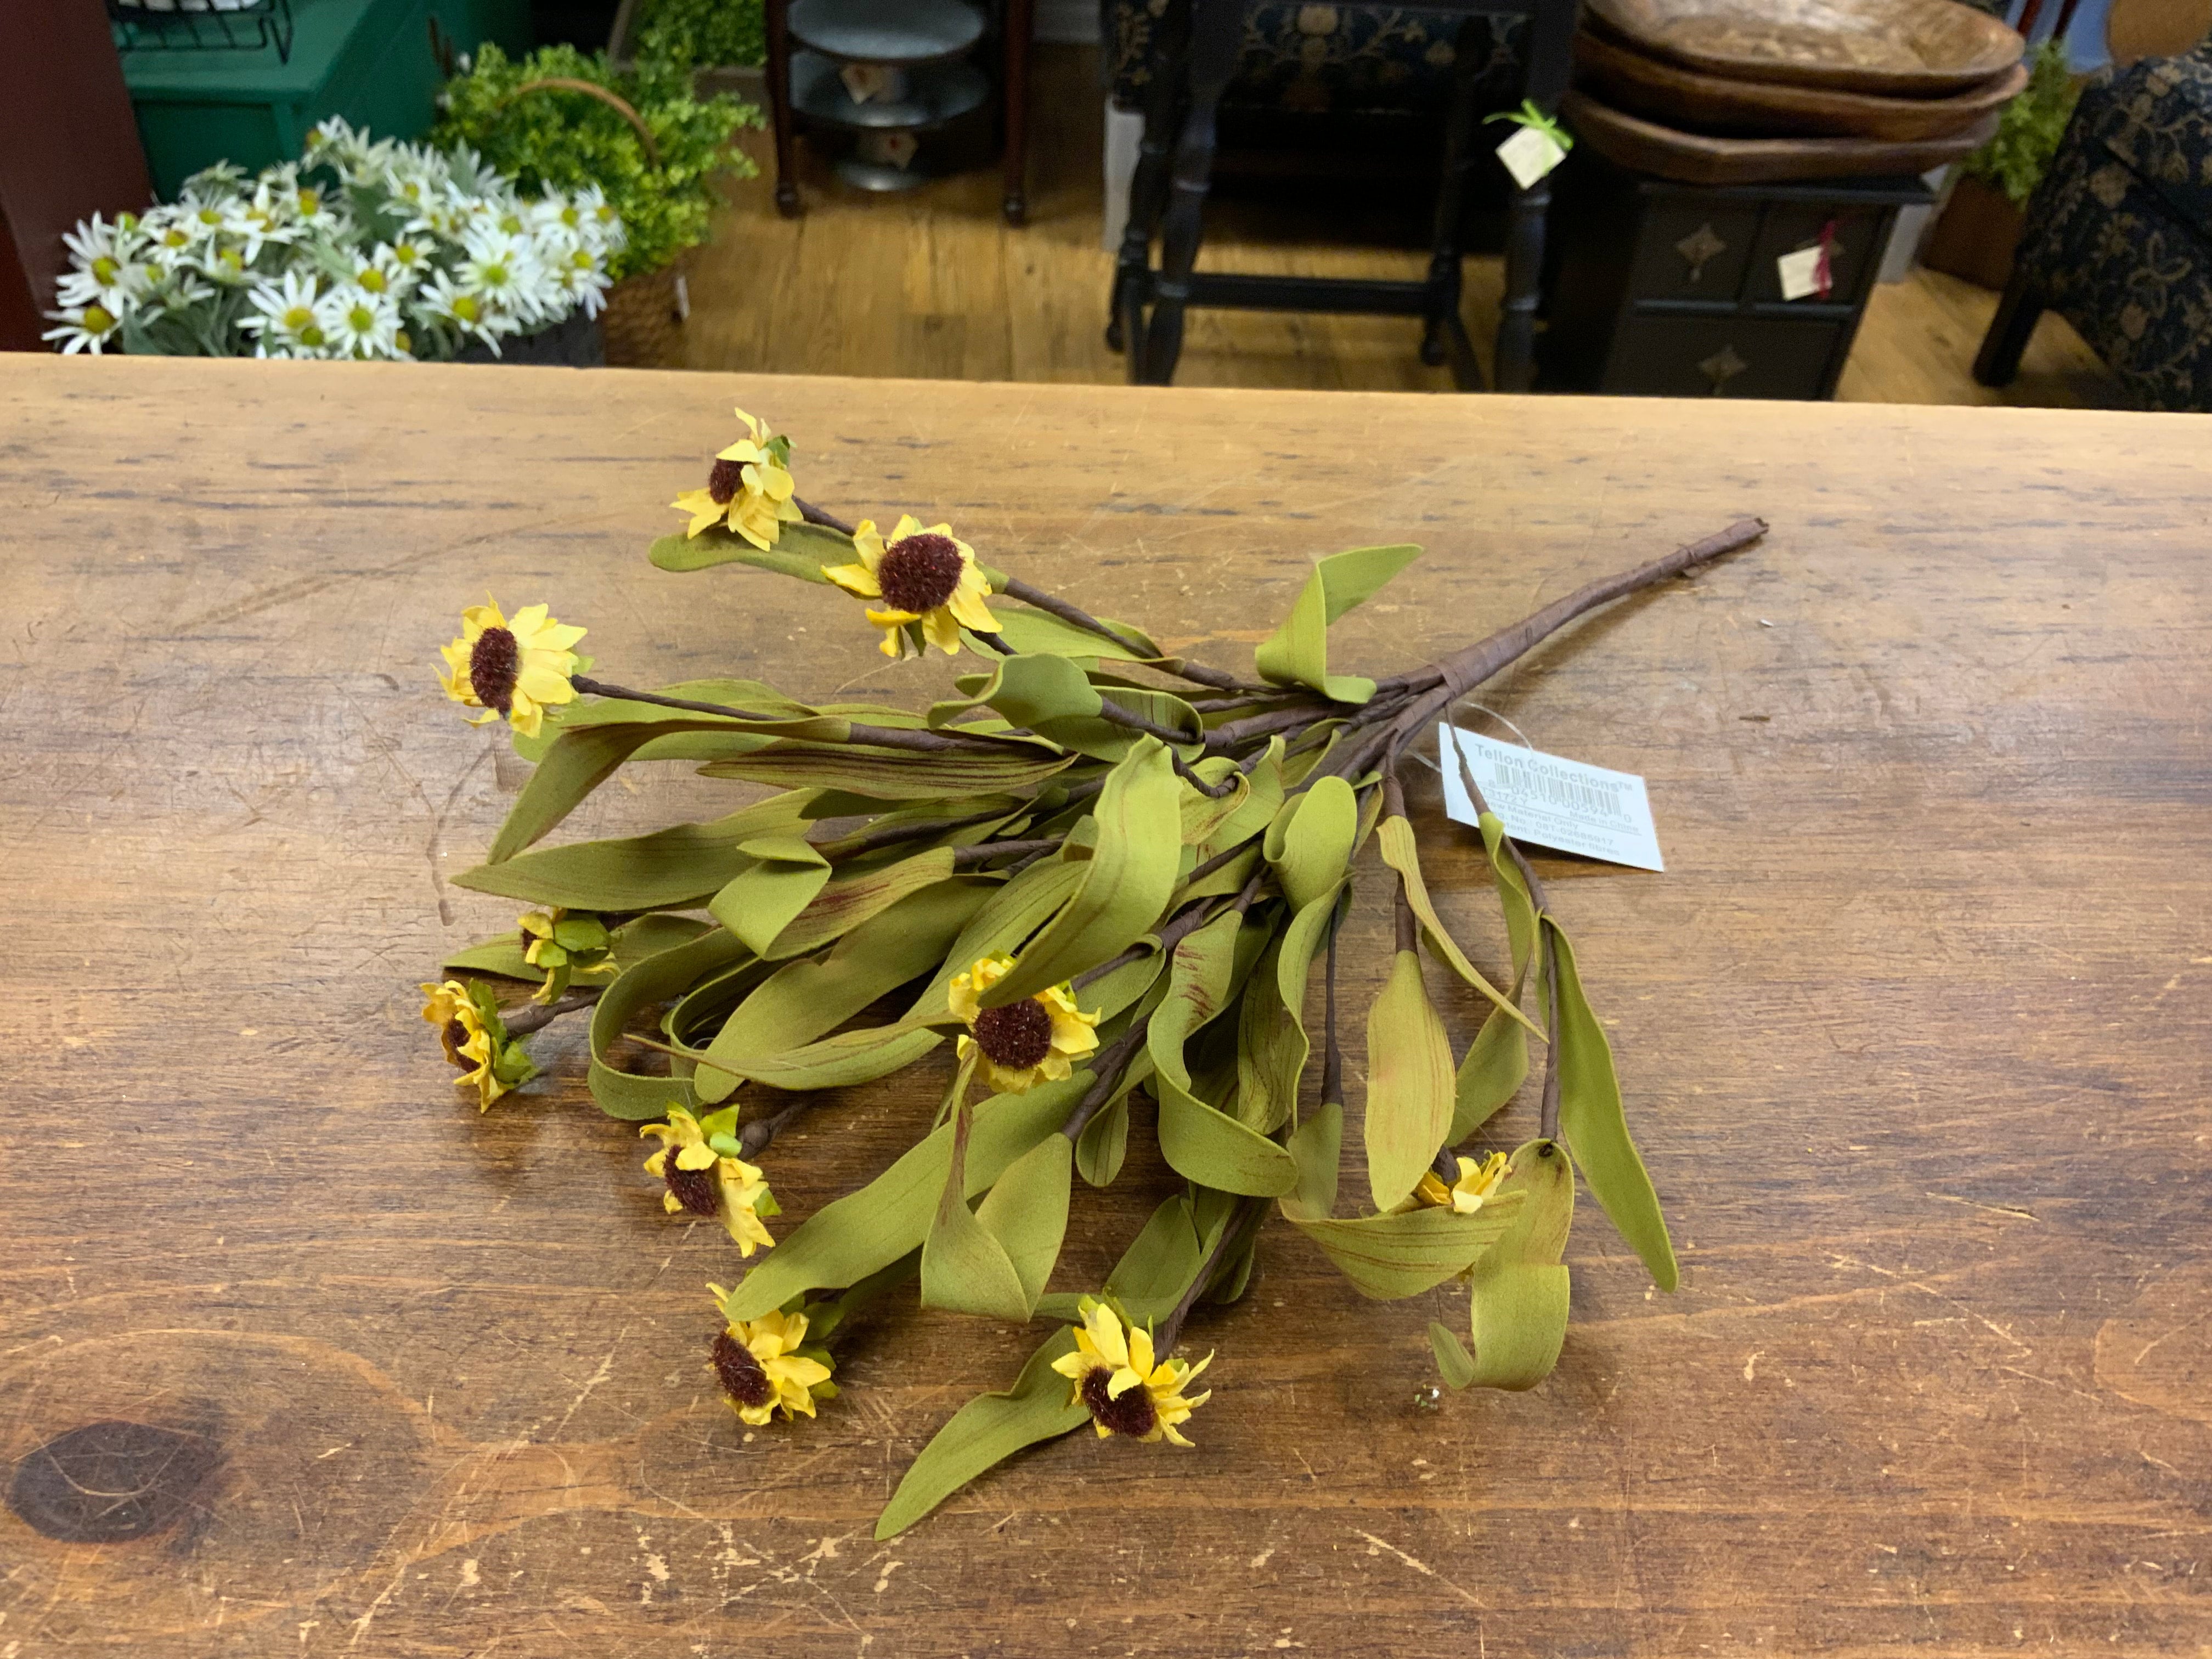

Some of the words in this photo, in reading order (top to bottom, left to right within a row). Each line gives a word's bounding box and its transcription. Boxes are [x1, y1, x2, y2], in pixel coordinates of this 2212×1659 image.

[1508, 804, 1551, 822] Material
[1554, 816, 1578, 830] Only
[1570, 810, 1596, 822] Made
[1623, 814, 1633, 823] 0
[1534, 829, 1585, 848] Polyester
